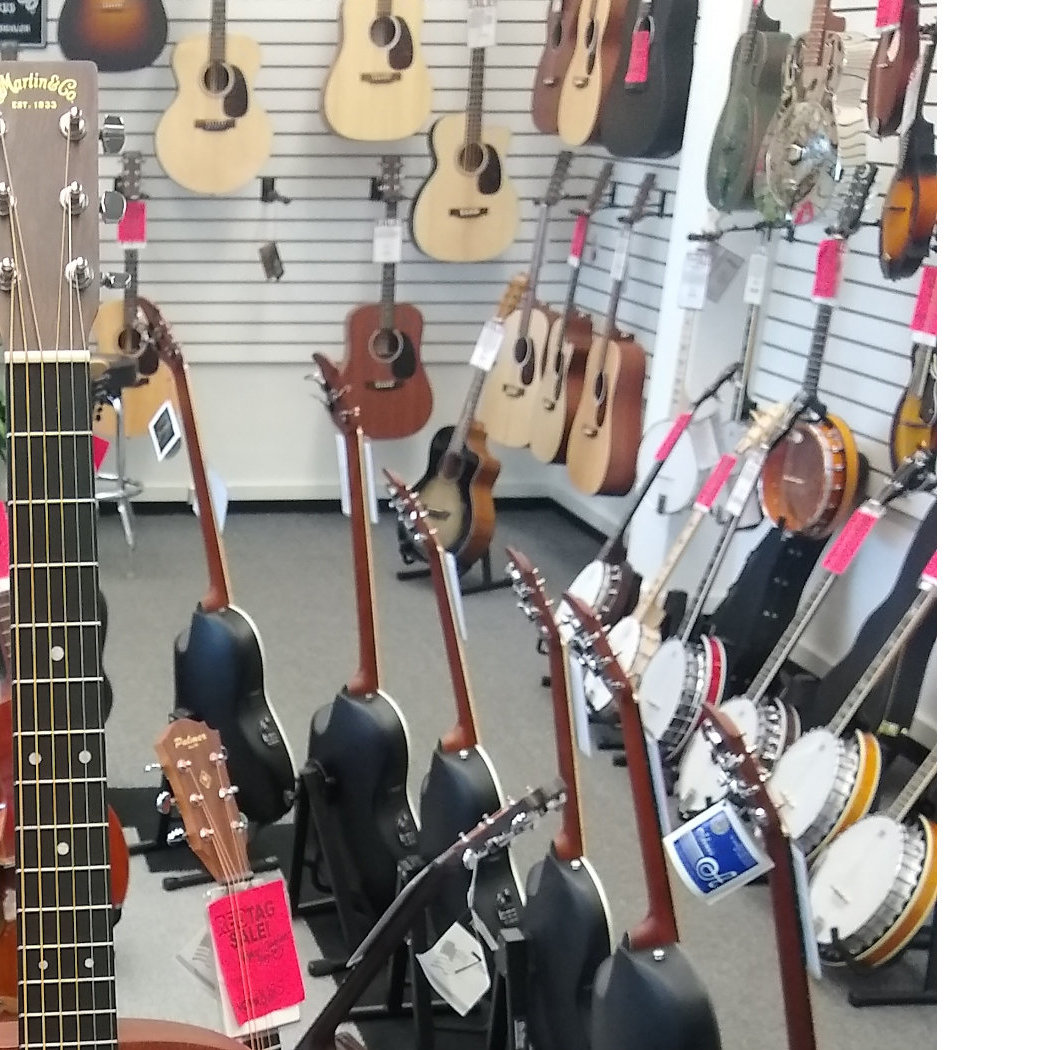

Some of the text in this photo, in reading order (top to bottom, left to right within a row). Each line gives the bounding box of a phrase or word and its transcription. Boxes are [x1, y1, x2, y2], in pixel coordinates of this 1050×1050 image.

[11, 100, 57, 109] EST. 1833
[246, 901, 275, 921] TAG
